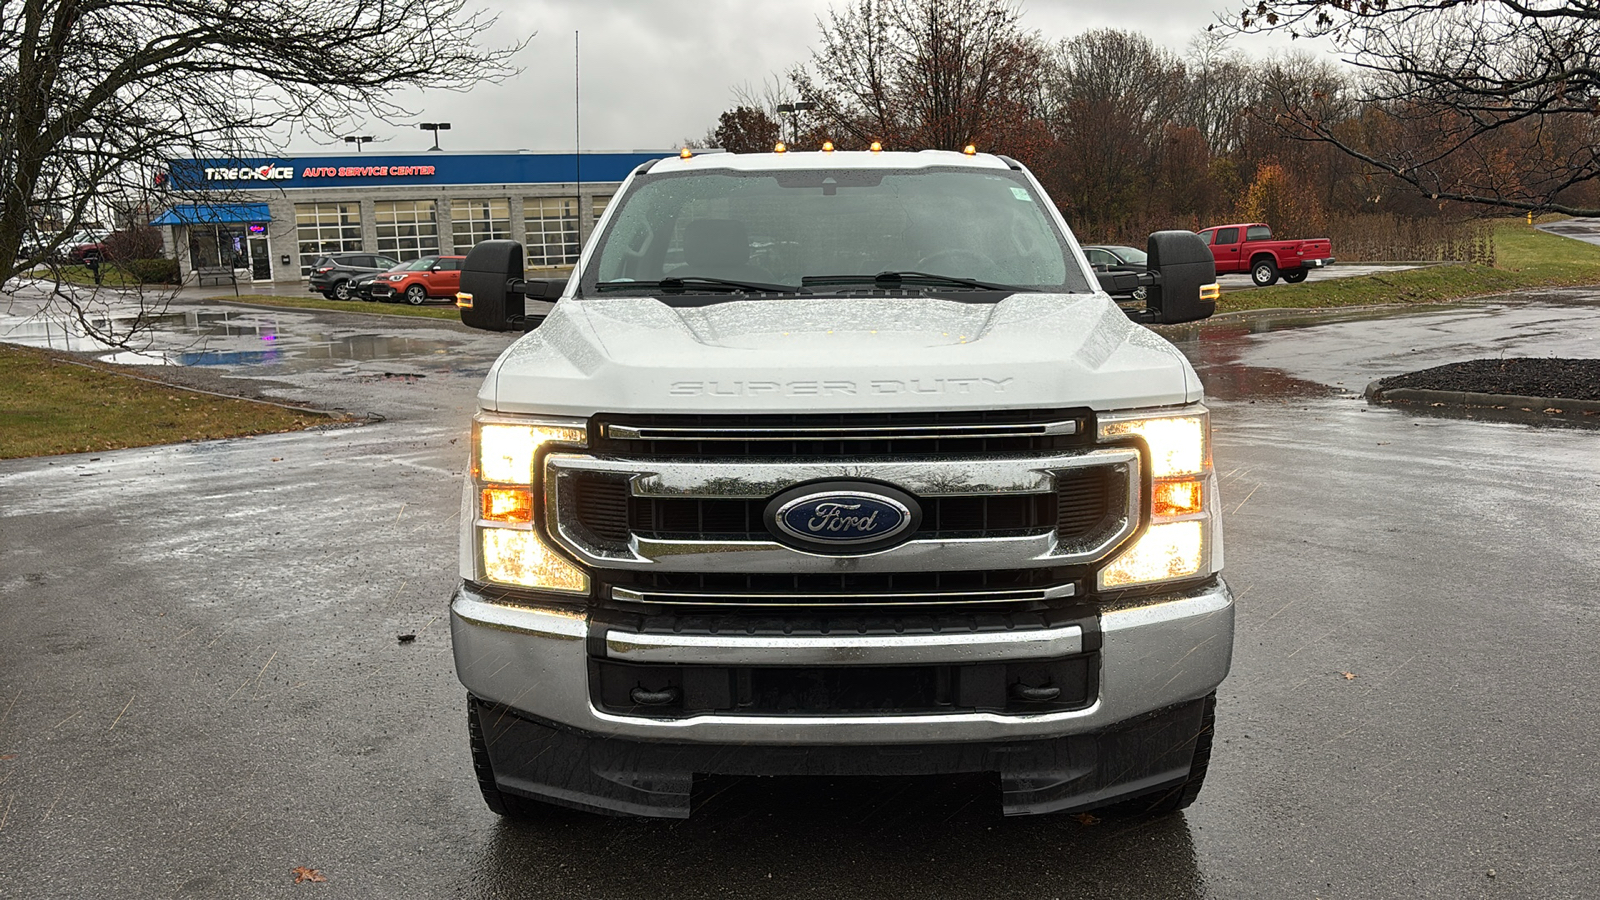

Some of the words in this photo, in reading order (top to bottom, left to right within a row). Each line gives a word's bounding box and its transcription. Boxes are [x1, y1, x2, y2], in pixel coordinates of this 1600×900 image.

[302, 167, 337, 178] AUTO
[338, 166, 389, 177] SERVICE
[389, 165, 436, 177] CENTER
[669, 380, 857, 397] SUPER
[871, 377, 1014, 395] DUTY
[807, 502, 879, 533] Ford
